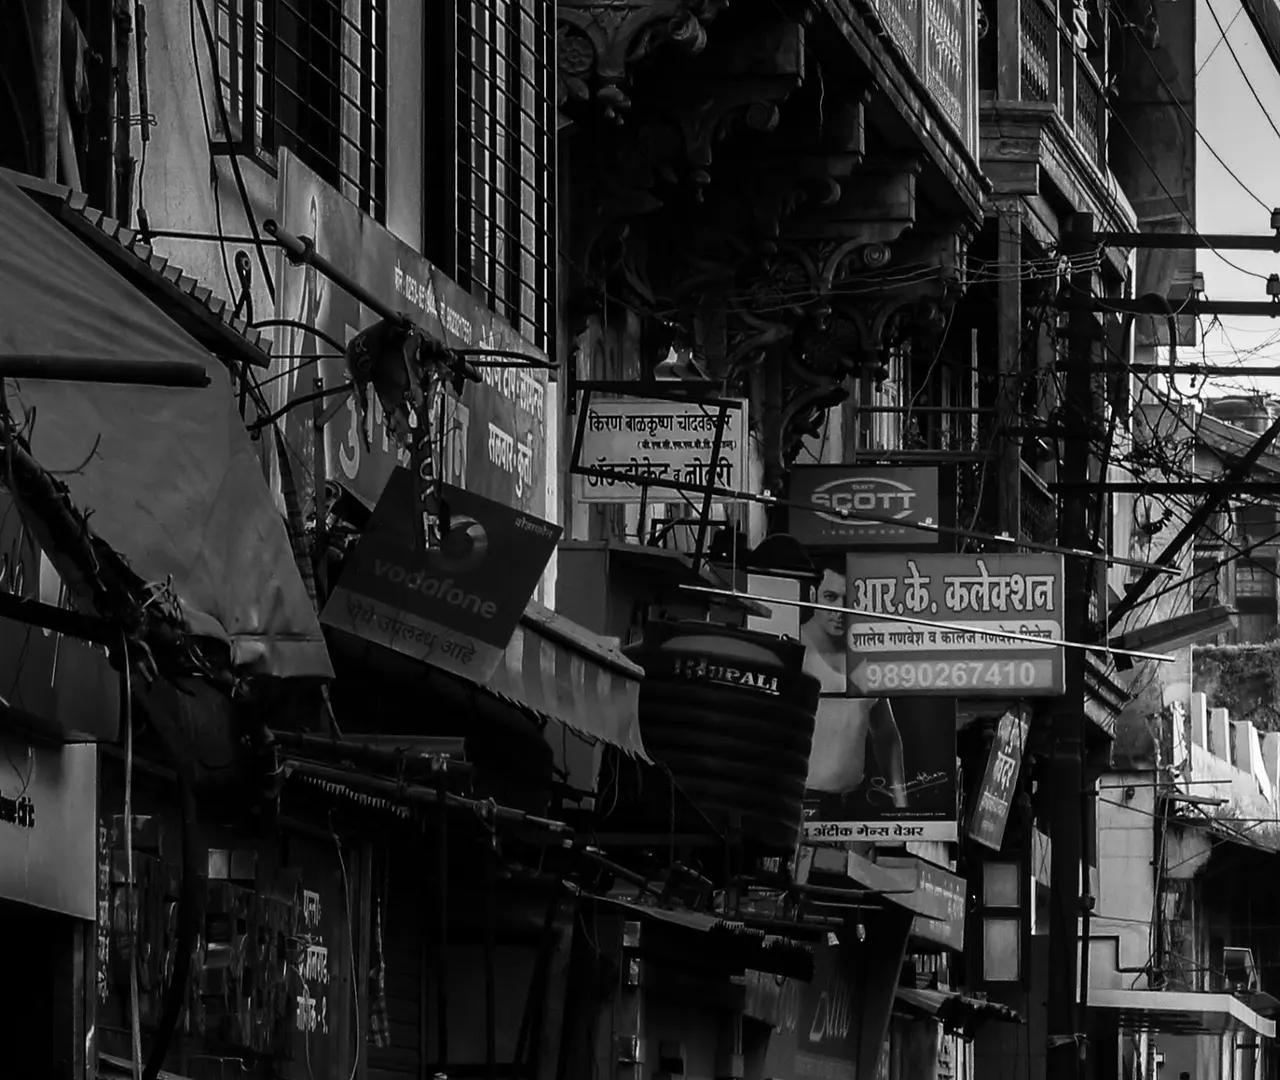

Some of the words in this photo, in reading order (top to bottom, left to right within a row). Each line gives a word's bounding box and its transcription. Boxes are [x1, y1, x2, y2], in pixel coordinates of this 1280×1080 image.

[810, 492, 917, 510] SCOTT
[372, 557, 499, 621] vodafone
[943, 559, 1056, 613] कलेक्शन
[865, 661, 1036, 688] 9890267410
